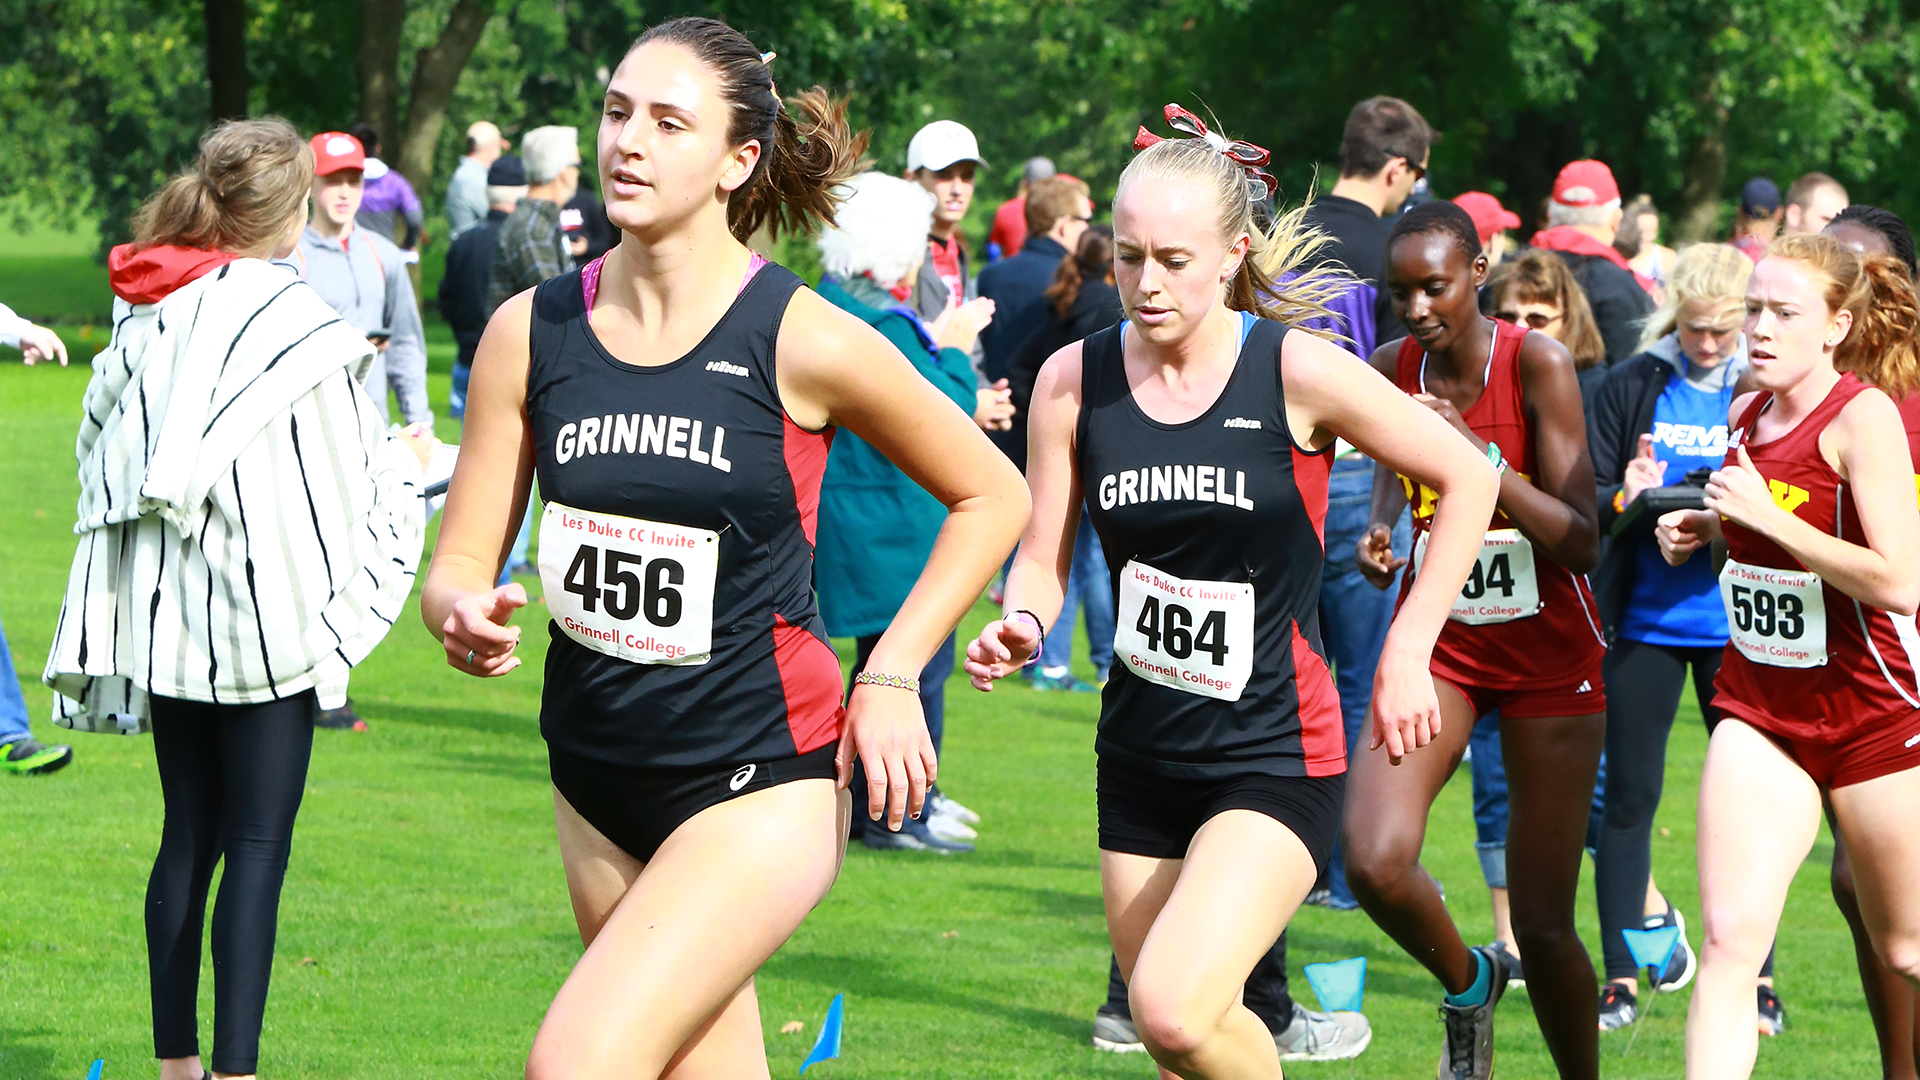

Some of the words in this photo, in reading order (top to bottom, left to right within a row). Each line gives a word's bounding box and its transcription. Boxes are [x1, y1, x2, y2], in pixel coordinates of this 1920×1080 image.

[555, 413, 732, 473] GRINNELL
[1099, 465, 1254, 511] GRINNELL
[562, 513, 583, 531] Les
[588, 519, 622, 539] Duke
[629, 526, 645, 543] CC
[651, 531, 696, 549] Invite
[563, 544, 684, 628] 456
[1135, 568, 1150, 584] Les
[1153, 575, 1176, 595] Duke
[1180, 586, 1194, 599] CC
[1199, 588, 1237, 601] Invite
[1461, 552, 1515, 599] 94
[1741, 569, 1761, 581] Duke
[1764, 573, 1775, 584] CC
[1778, 575, 1806, 587] Invite
[1136, 594, 1229, 667] 464
[1479, 606, 1522, 617] College
[1731, 583, 1804, 640] 593
[564, 616, 620, 644] Grinnell
[625, 634, 686, 659] College
[1769, 646, 1809, 660] College
[1130, 654, 1177, 679] Grinnell
[1182, 670, 1232, 691] College
